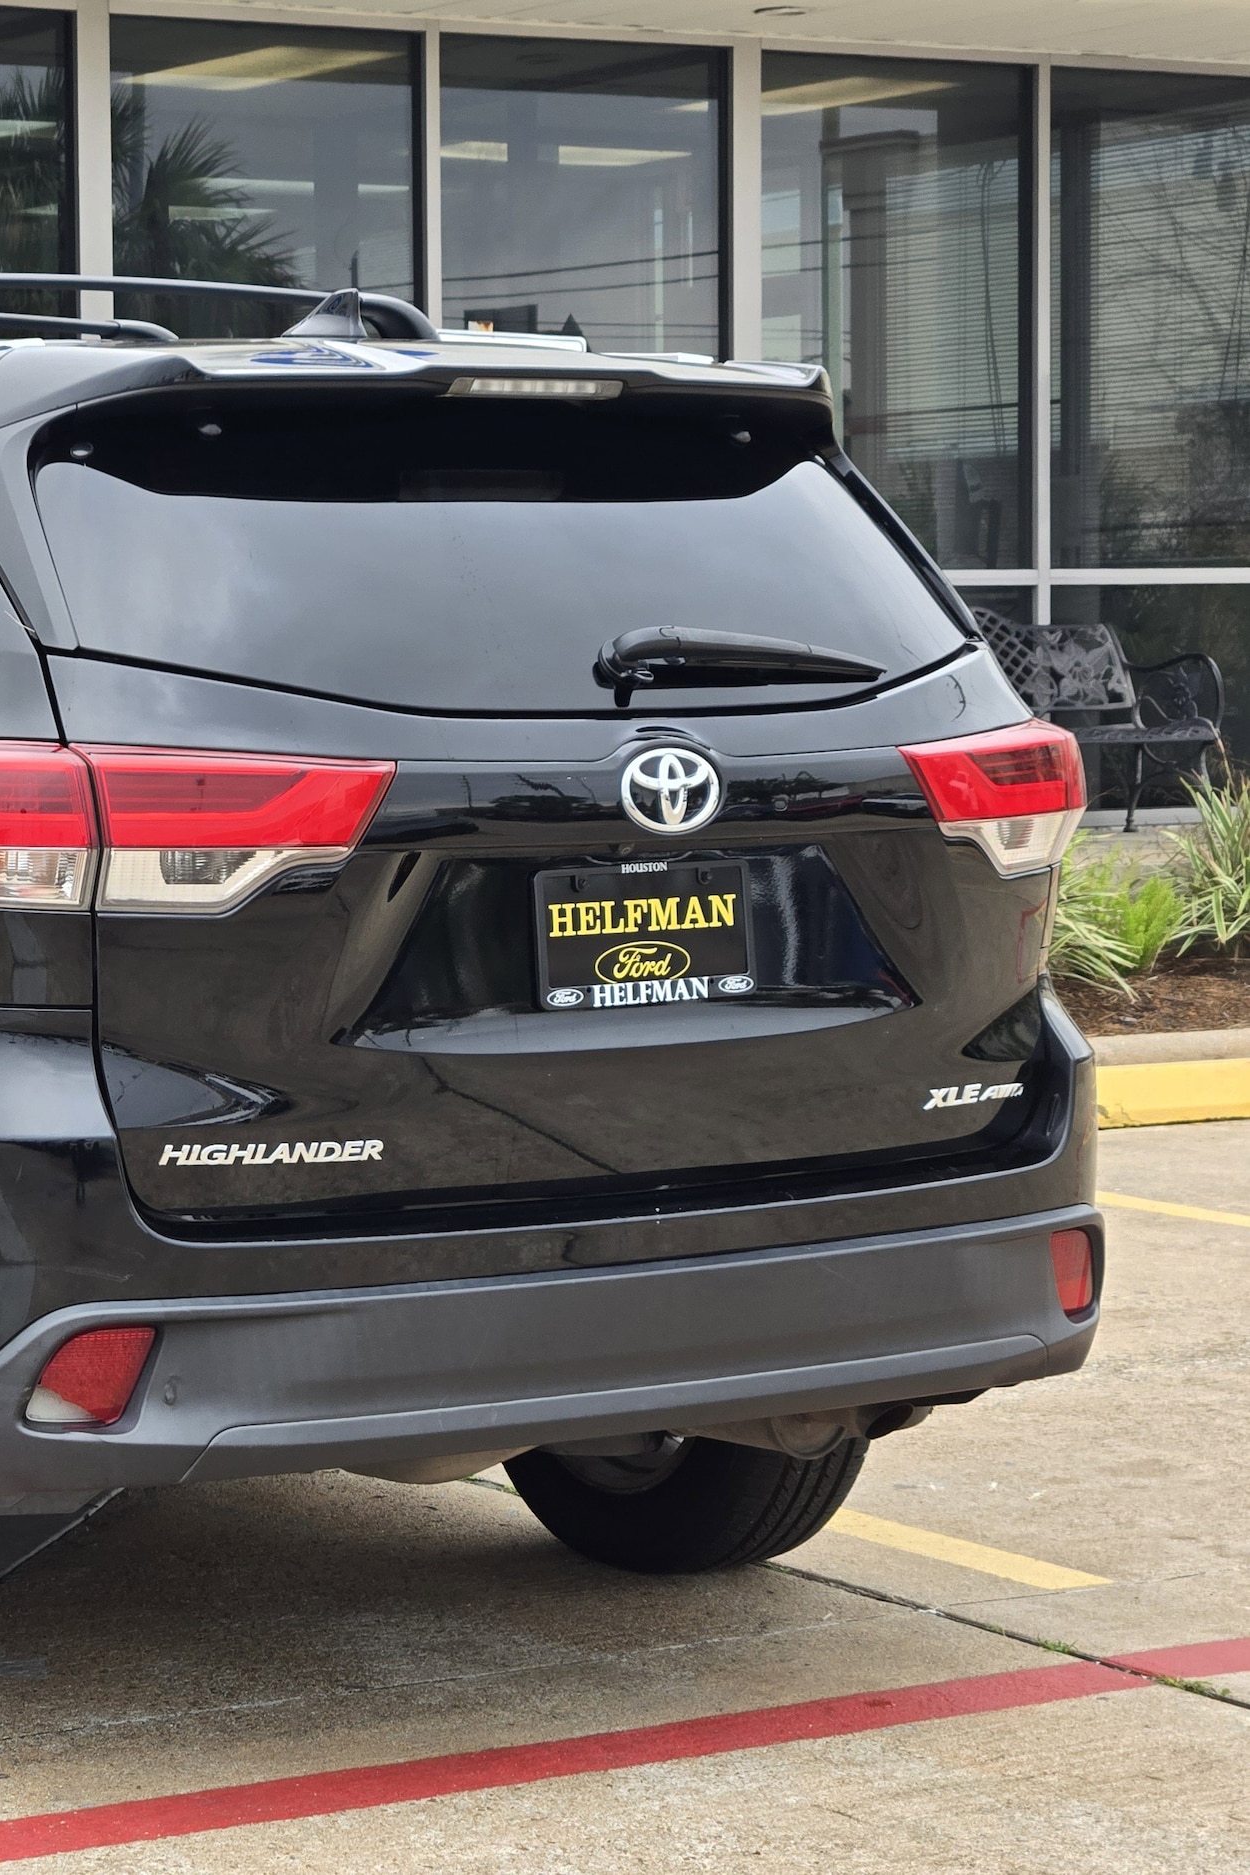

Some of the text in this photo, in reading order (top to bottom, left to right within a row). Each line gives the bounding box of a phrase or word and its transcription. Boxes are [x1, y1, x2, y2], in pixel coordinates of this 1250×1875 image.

[621, 862, 668, 874] HOUSTON
[548, 894, 736, 937] HELFMAN
[613, 947, 672, 979] Ford
[590, 976, 710, 1008] HELFMAN
[923, 1083, 982, 1110] XLE
[159, 1140, 384, 1166] HIGHLANDER
